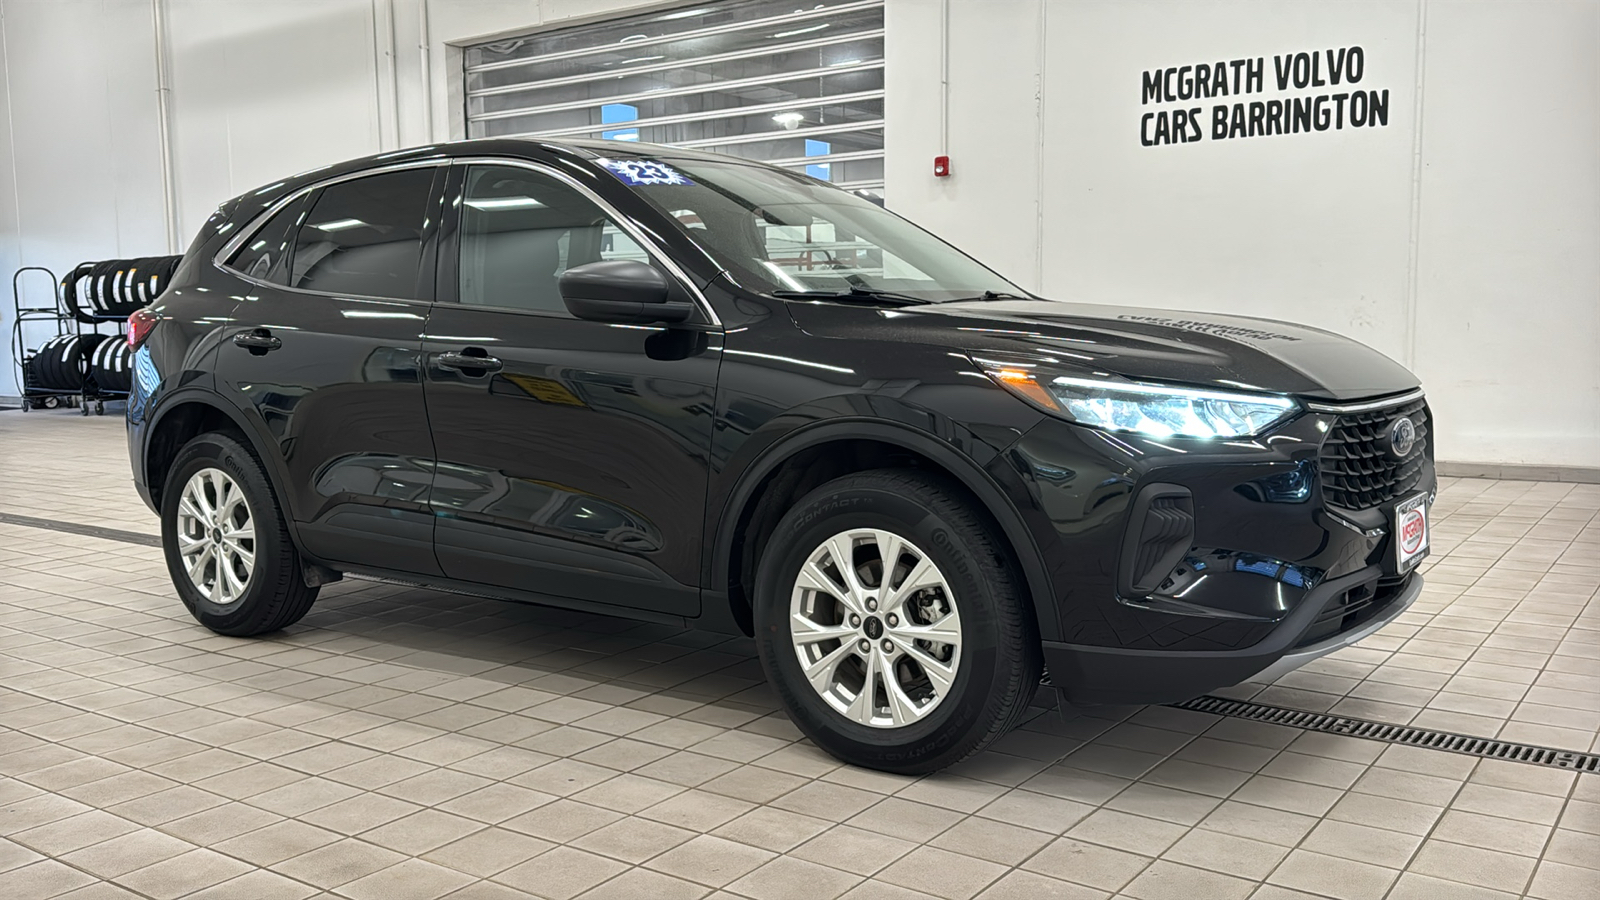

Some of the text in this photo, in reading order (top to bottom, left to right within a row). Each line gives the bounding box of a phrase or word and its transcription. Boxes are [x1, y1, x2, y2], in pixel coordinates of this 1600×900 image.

[1142, 46, 1364, 105] MCGRATH VOLVO
[1141, 89, 1389, 147] CARS BARRINGTON
[627, 164, 669, 179] 23
